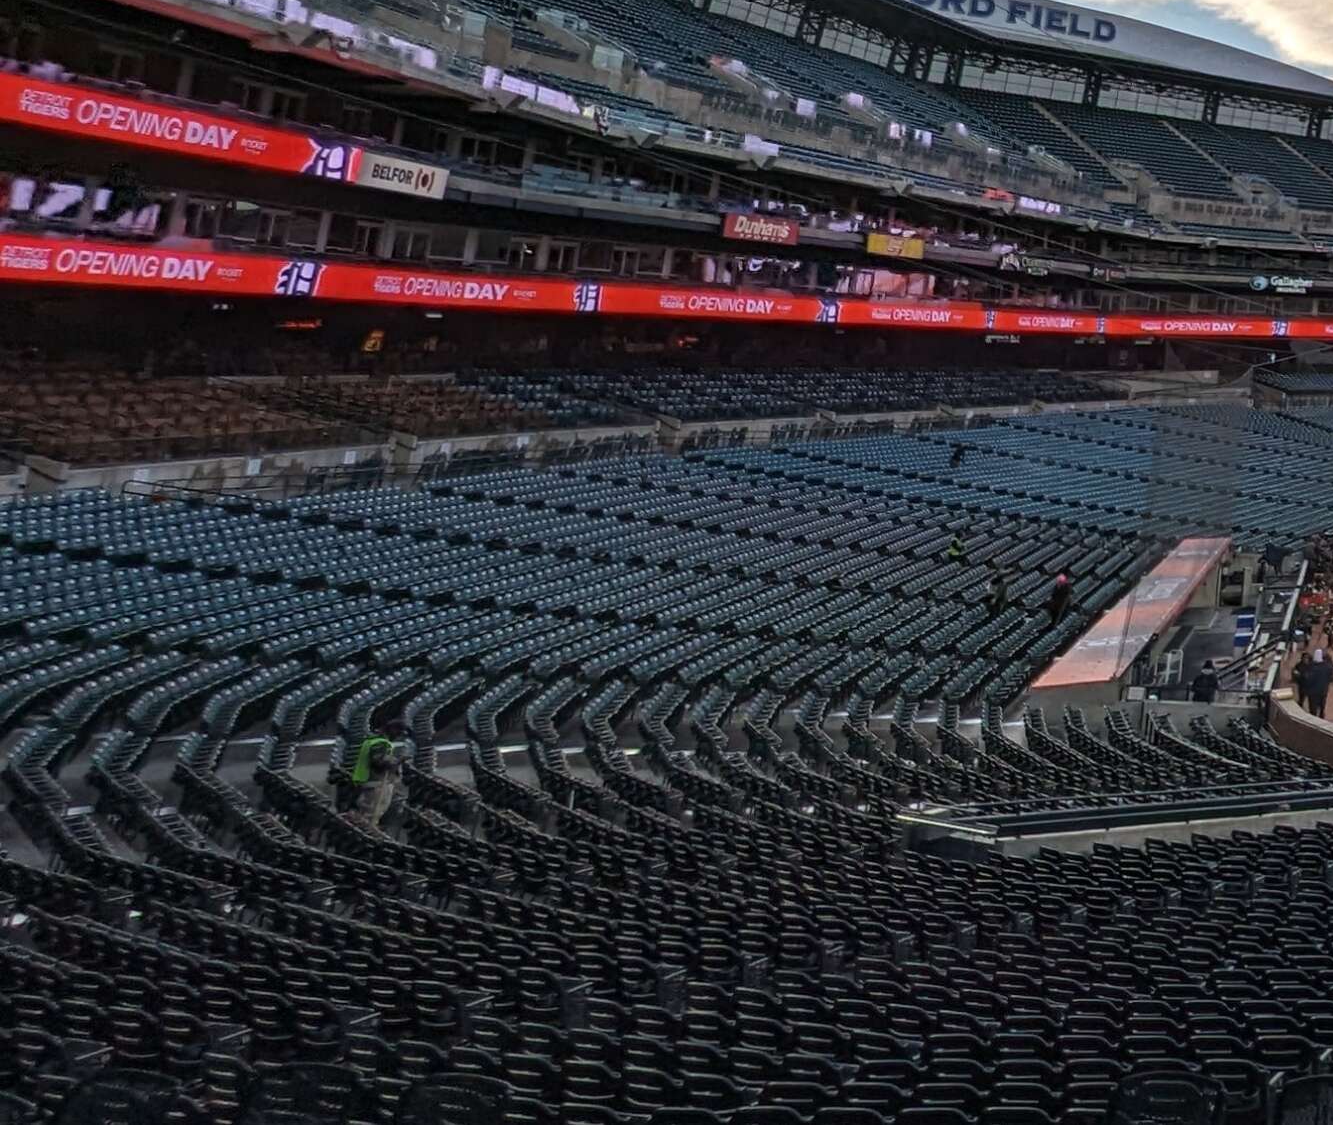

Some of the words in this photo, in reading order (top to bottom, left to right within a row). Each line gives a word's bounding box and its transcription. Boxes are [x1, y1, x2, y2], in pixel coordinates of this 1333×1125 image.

[1006, 0, 1117, 42] FIELD
[20, 100, 70, 120] TIGERS
[76, 99, 184, 141] OPENING
[184, 125, 239, 151] DAY
[371, 162, 414, 186] BELFOR
[734, 215, 790, 238] Dunham's
[56, 249, 159, 278] OPENING
[161, 258, 214, 281] DAY
[403, 277, 463, 299] OPENING
[463, 282, 509, 301] DAY
[688, 295, 745, 313] OPENING
[745, 298, 774, 315] DAY
[932, 310, 952, 324] DAY
[1164, 320, 1212, 333] OPENING
[1212, 322, 1237, 333] DAY
